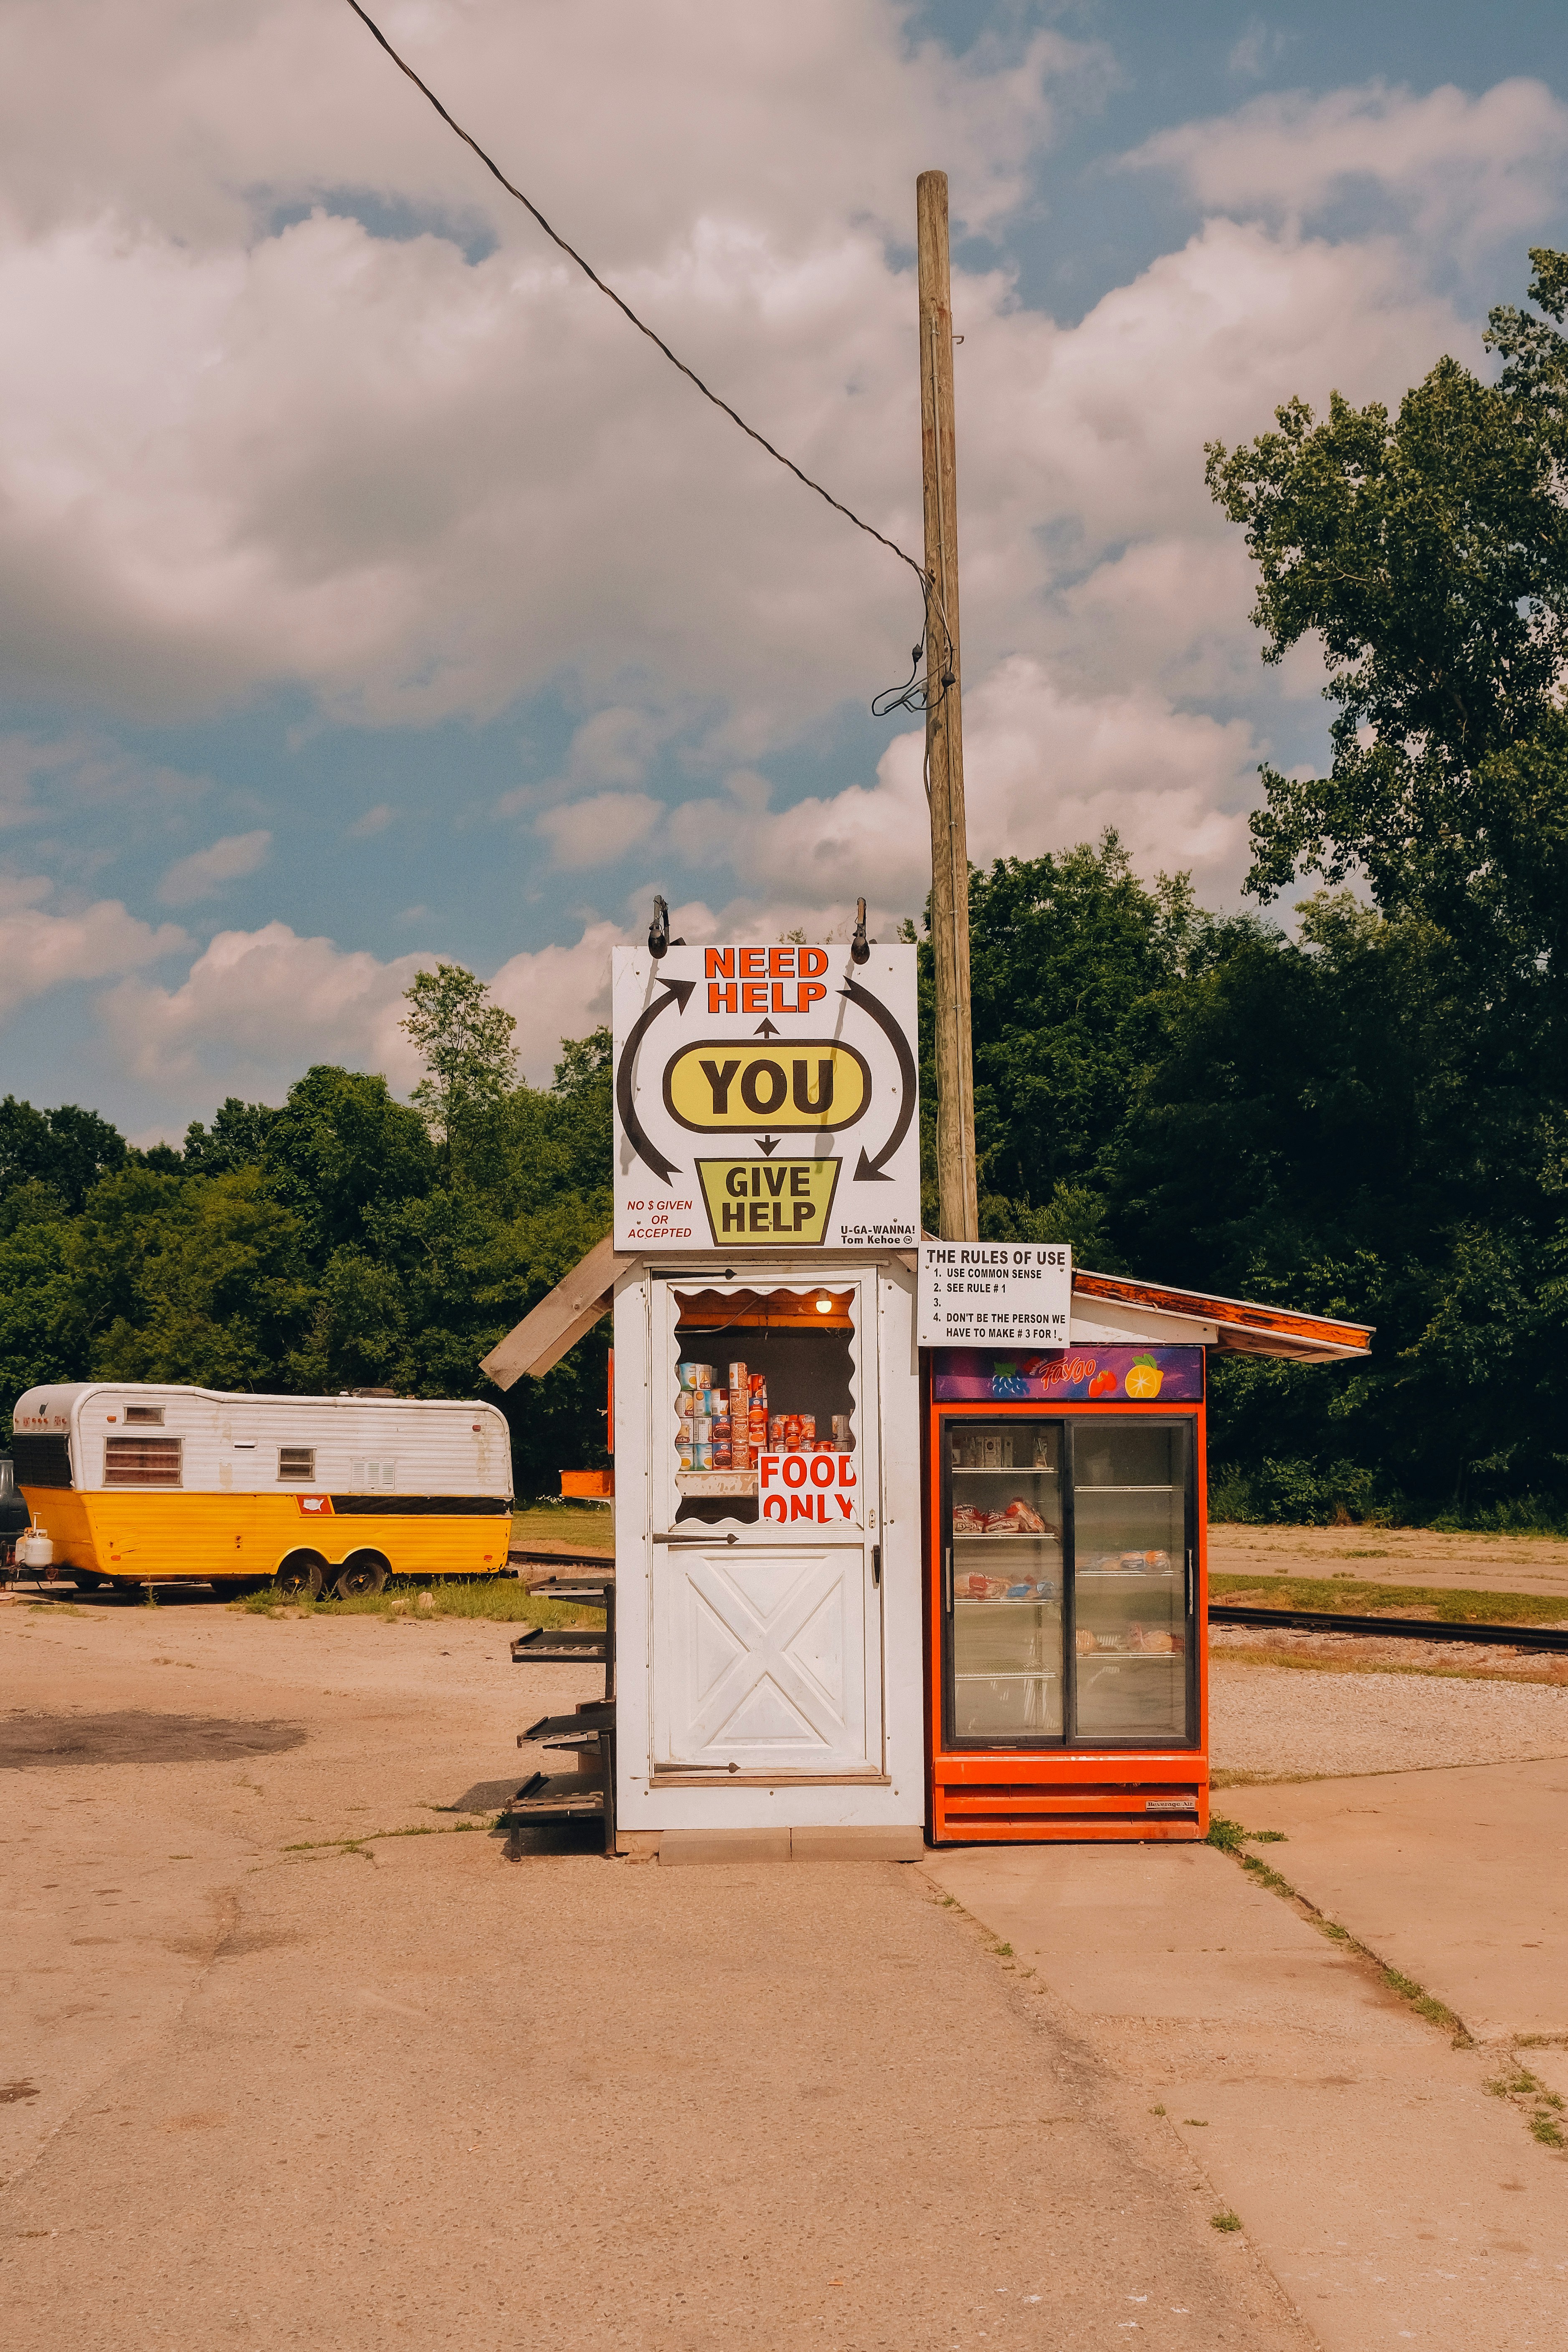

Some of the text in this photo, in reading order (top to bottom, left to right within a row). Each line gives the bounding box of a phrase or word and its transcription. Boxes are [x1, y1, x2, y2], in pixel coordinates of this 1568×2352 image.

[705, 948, 828, 978] NEED
[708, 982, 827, 1013] HELP
[699, 1060, 833, 1114] YOU
[726, 1167, 810, 1197] GIVE
[628, 1200, 692, 1210] NO $ GIVEN
[652, 1215, 668, 1224] OR
[722, 1202, 816, 1232] HELP
[628, 1228, 691, 1237] ACCEPTED
[841, 1225, 914, 1234] U-GA-WANNA!
[927, 1250, 1065, 1265] THE RULES OF USE
[935, 1268, 1041, 1279] 1. USE COMMON SENSE
[934, 1283, 941, 1292] 2.
[947, 1284, 963, 1292] SEE
[968, 1284, 990, 1292] RULE
[934, 1298, 941, 1306] 3.
[933, 1313, 1065, 1323] 4. DON'T BE THE PERSON WE
[947, 1328, 970, 1337] HAVE
[974, 1329, 985, 1337] TO
[989, 1329, 1014, 1337] MAKE
[1034, 1329, 1051, 1338] FOR
[1039, 1357, 1096, 1391] Faygo
[761, 1455, 856, 1488] FOOD
[763, 1494, 853, 1523] ONLY
